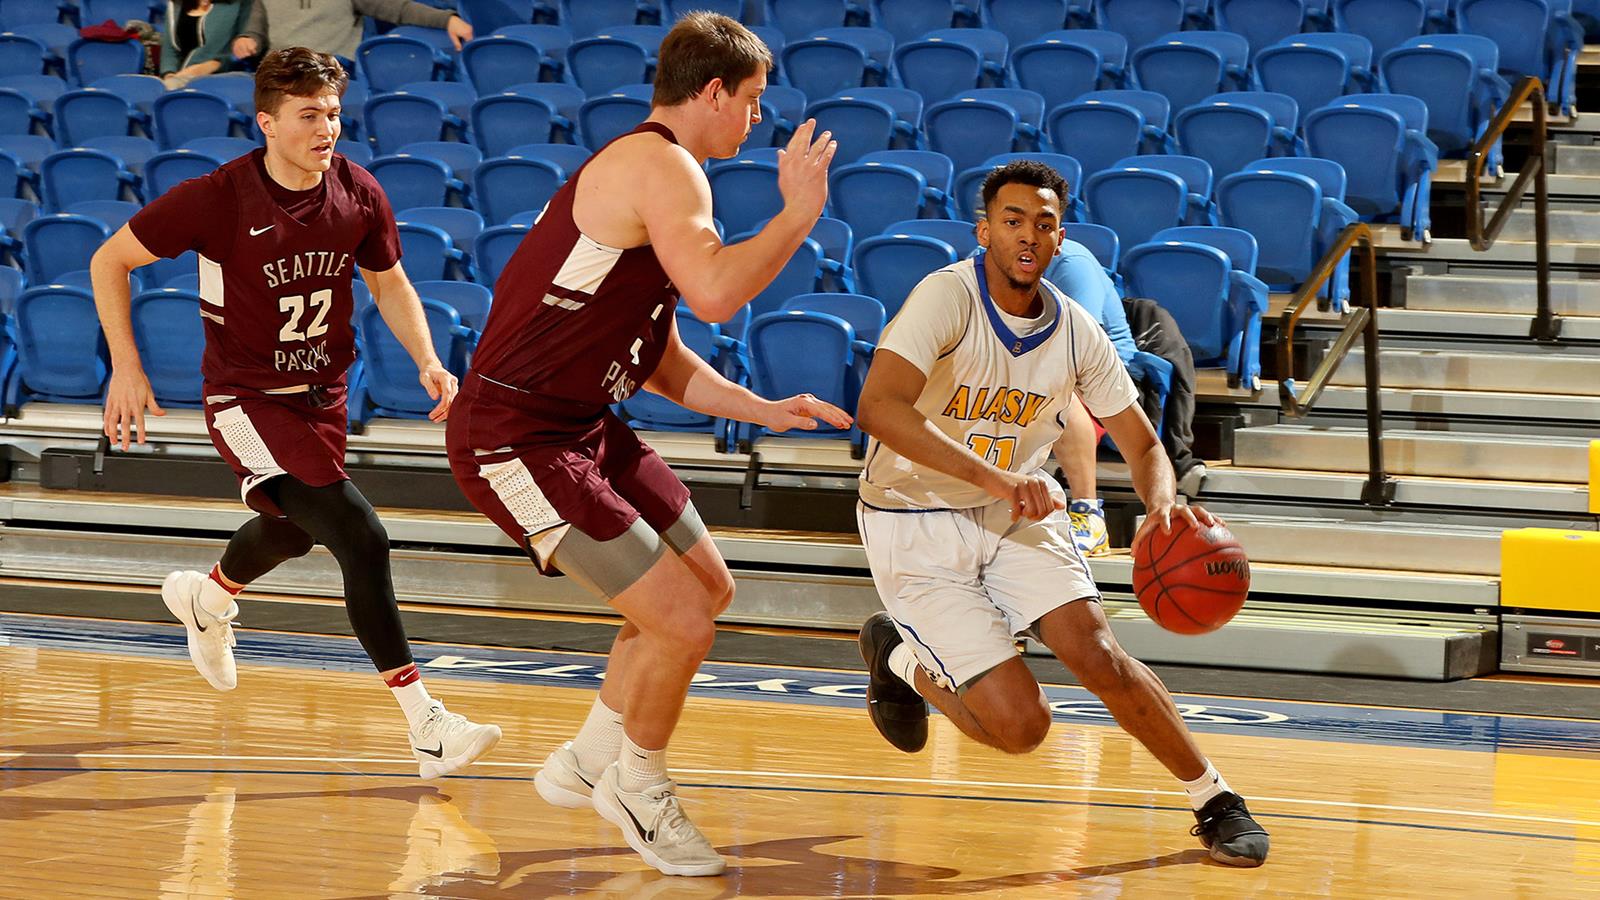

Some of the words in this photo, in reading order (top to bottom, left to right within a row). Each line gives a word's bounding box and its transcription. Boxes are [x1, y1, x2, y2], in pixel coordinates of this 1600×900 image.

[262, 251, 349, 288] SEATTLE
[279, 288, 333, 342] 22
[941, 384, 1054, 428] ALASK
[966, 433, 1017, 472] 11
[1204, 559, 1249, 581] lson
